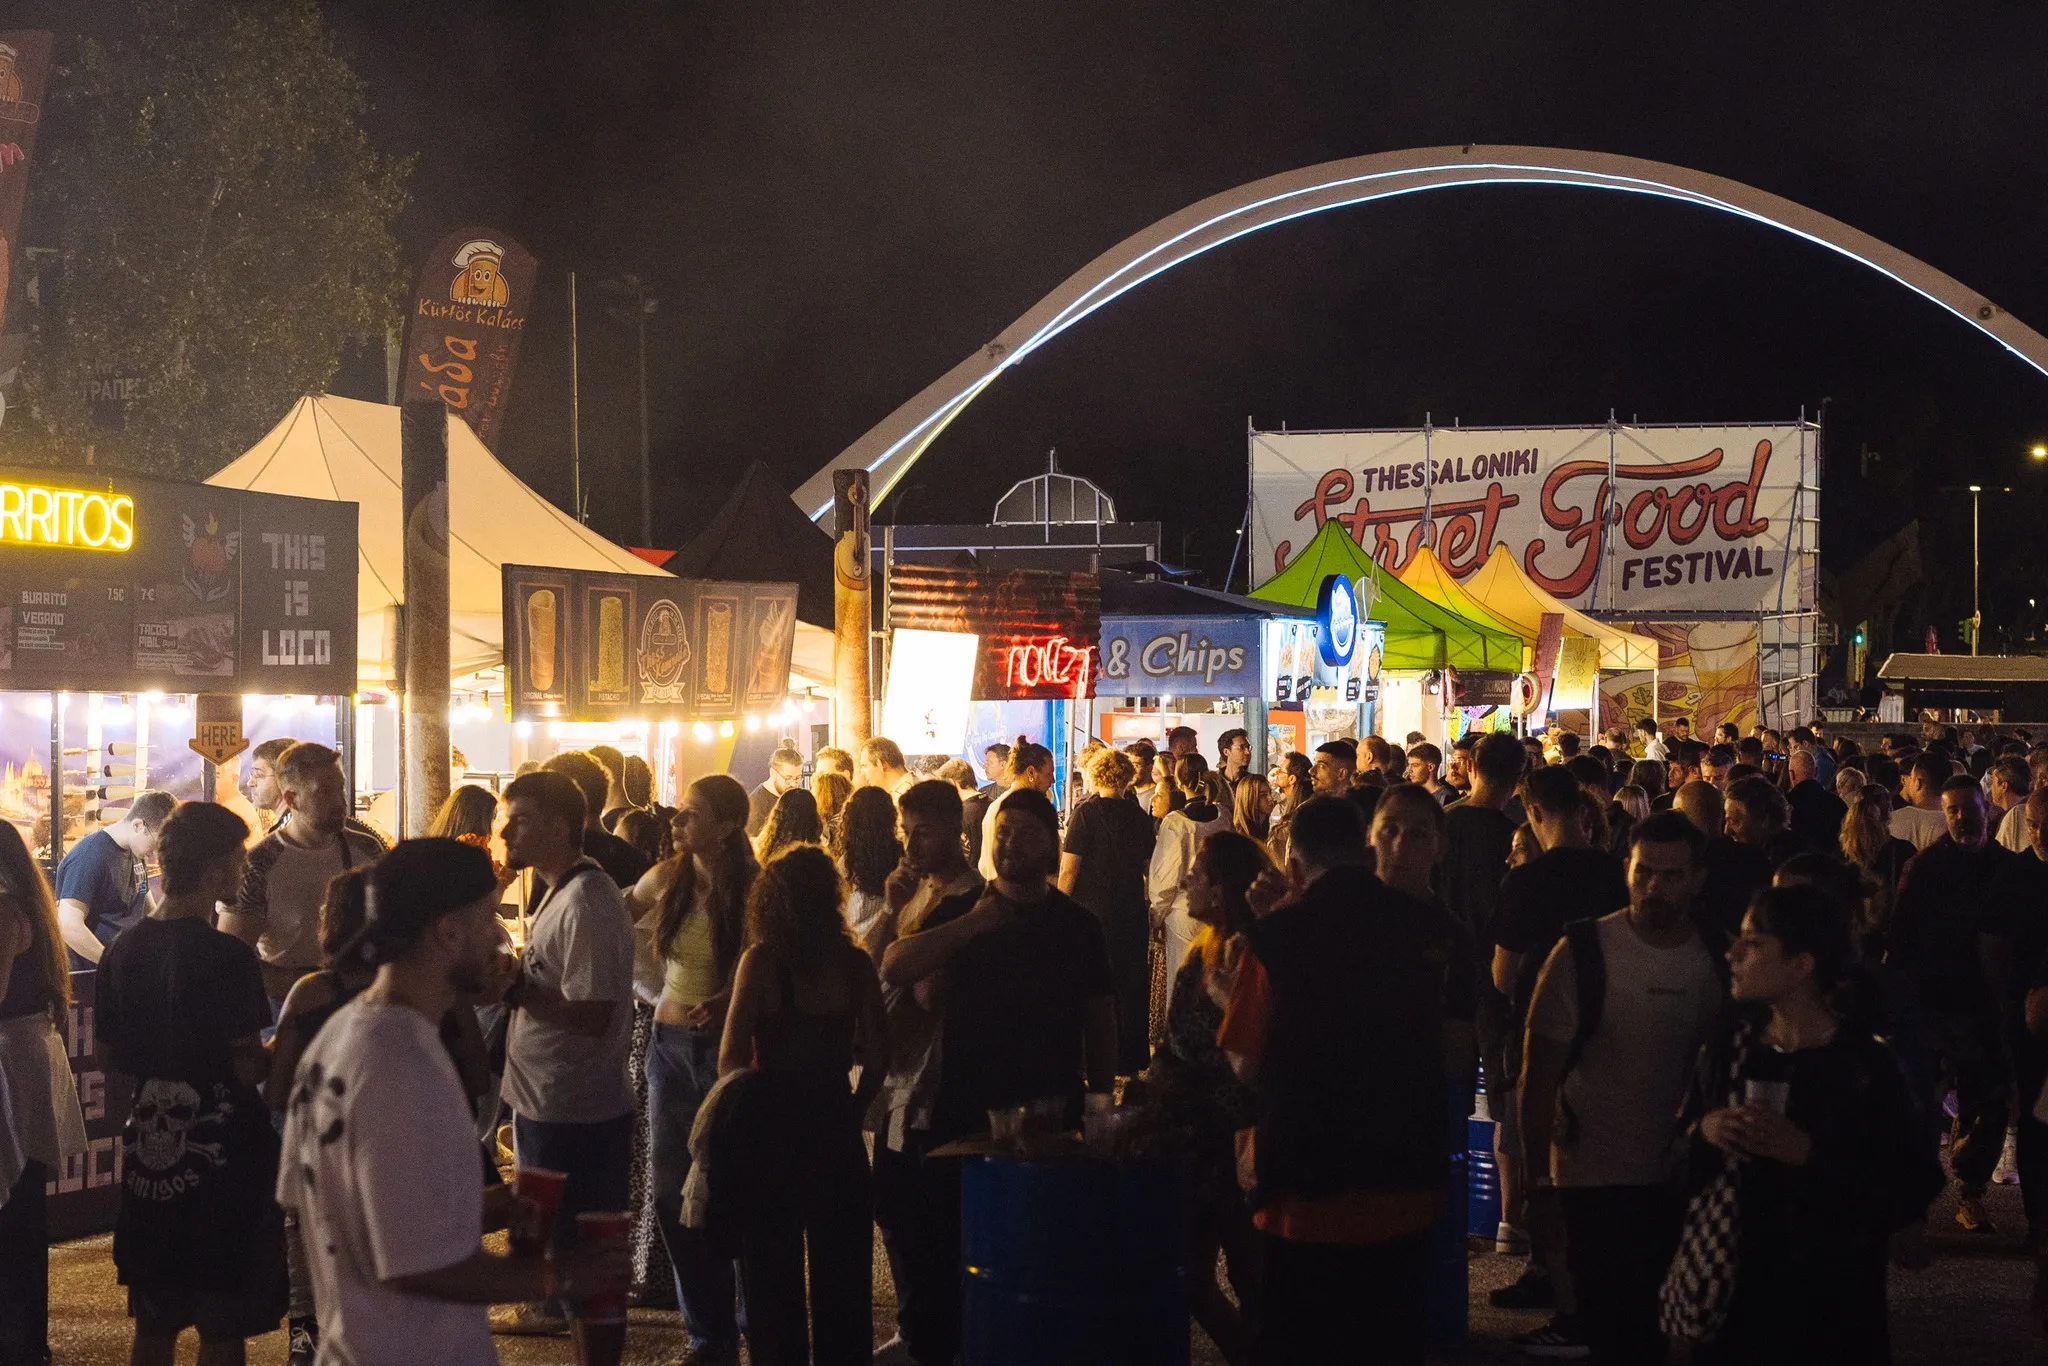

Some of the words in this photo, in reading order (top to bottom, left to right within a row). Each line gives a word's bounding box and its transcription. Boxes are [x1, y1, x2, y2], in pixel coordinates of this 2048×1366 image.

[418, 298, 472, 323] Kürtös
[1363, 448, 1539, 493] THESSALONIKI
[1275, 469, 1519, 581] Street
[1524, 438, 1773, 599] Food
[1621, 546, 1774, 591] FESTIVAL
[22, 591, 67, 606] BURRITO
[22, 611, 65, 626] VEGANO
[139, 624, 168, 636] TACOS
[262, 629, 331, 665] LOCO
[1107, 637, 1131, 677] &
[1141, 631, 1245, 685] Chips
[201, 726, 236, 746] HERE
